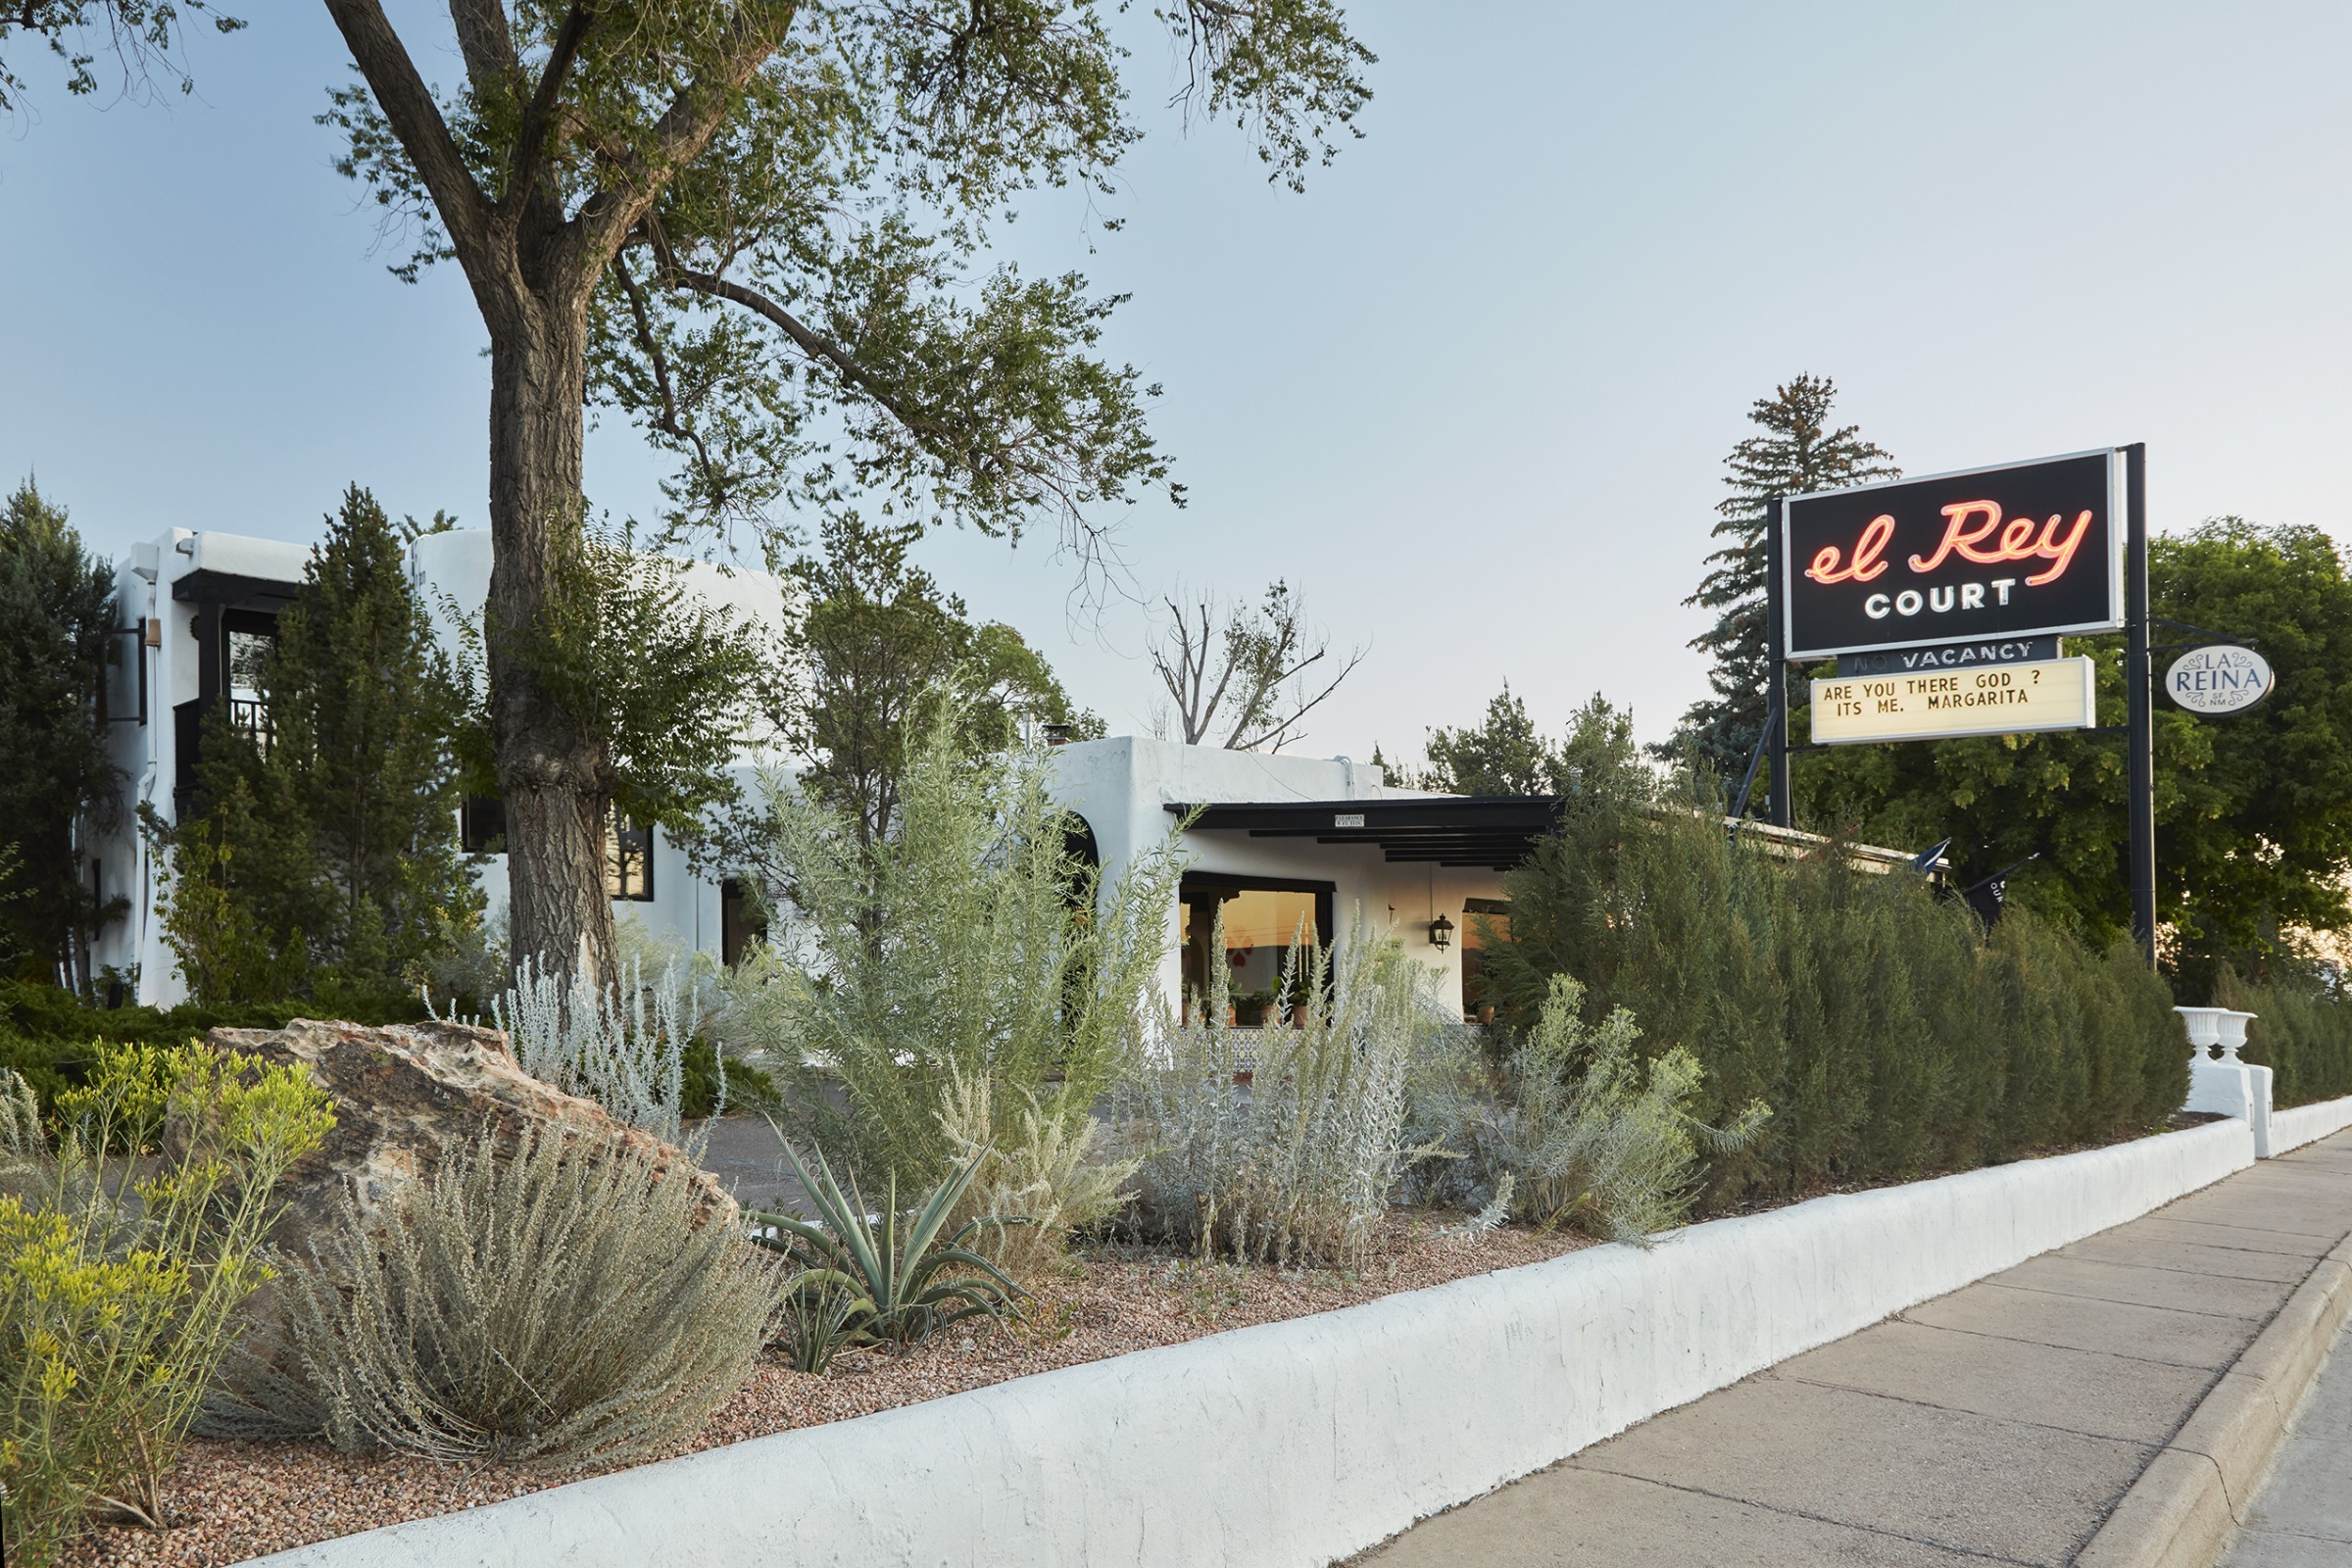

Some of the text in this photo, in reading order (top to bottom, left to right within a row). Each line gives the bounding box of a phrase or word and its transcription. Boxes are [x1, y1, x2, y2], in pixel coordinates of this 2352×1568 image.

[1804, 499, 2093, 588] el Rey
[1864, 578, 2016, 619] COURT
[1854, 641, 2034, 672] NO VACANCY
[2205, 653, 2231, 670] LA
[1824, 669, 2040, 702] ARE YOU THERE GOD ?
[2177, 668, 2262, 692] REINA
[1837, 689, 2029, 716] ITS ME. MARGARITA
